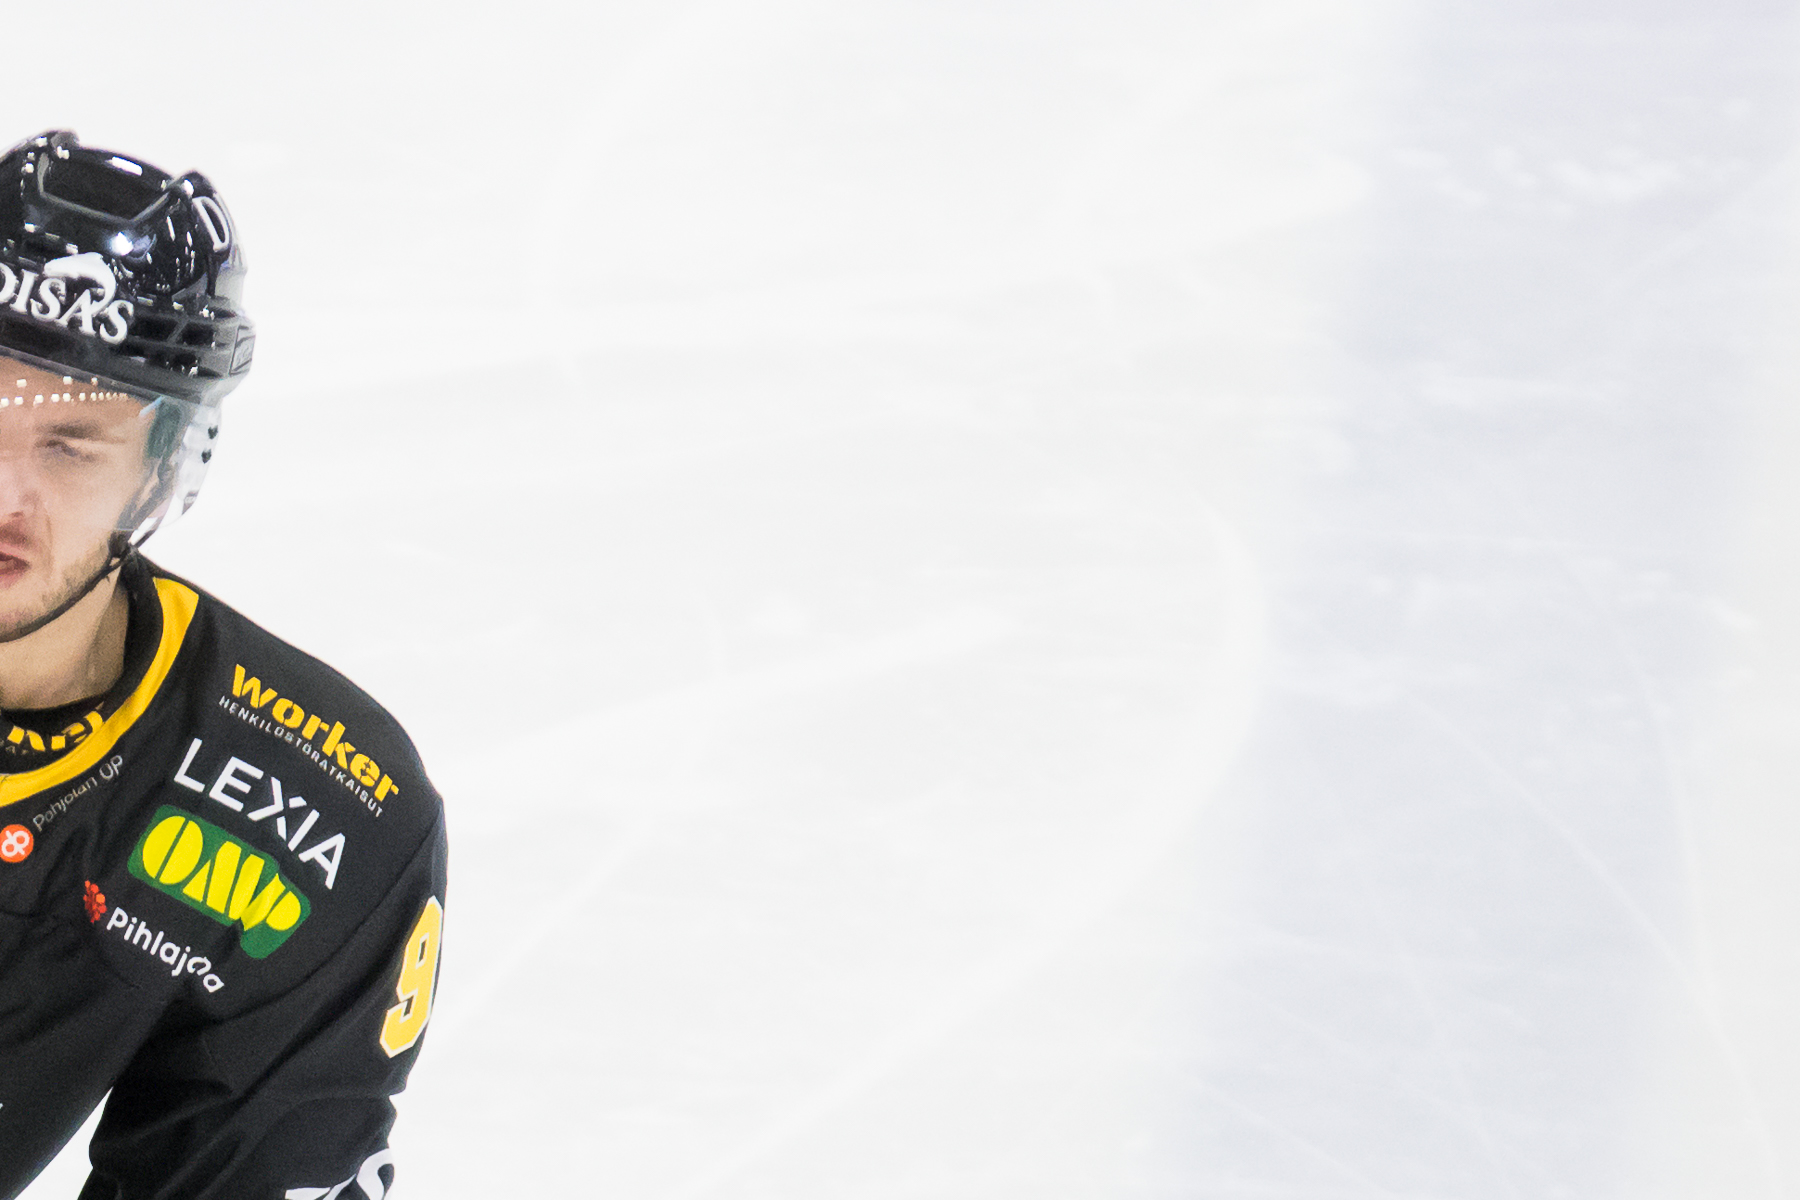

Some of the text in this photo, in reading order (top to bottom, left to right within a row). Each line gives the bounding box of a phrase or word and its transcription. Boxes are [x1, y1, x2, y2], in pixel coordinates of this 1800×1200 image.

[232, 663, 399, 803] worker
[33, 775, 98, 832] Pohjolan
[173, 738, 346, 889] LEXIA
